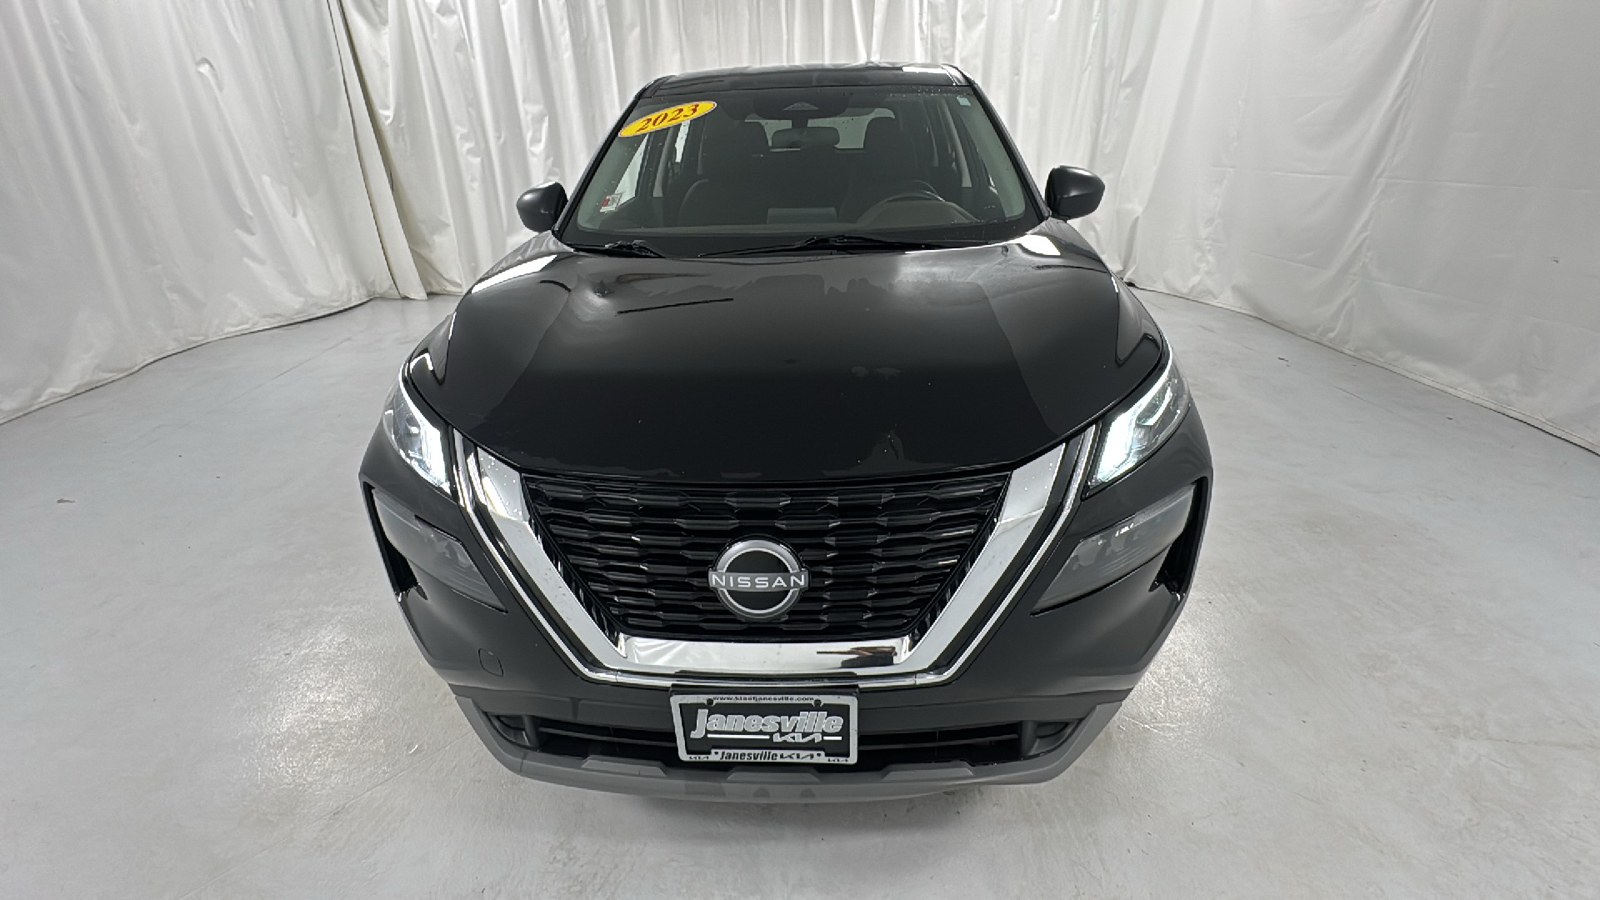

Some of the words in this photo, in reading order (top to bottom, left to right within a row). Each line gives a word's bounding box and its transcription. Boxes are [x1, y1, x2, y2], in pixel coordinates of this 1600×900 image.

[635, 103, 700, 133] 2023
[711, 574, 805, 588] NISSAN
[690, 708, 844, 739] Janesville
[720, 750, 778, 761] Janesville
